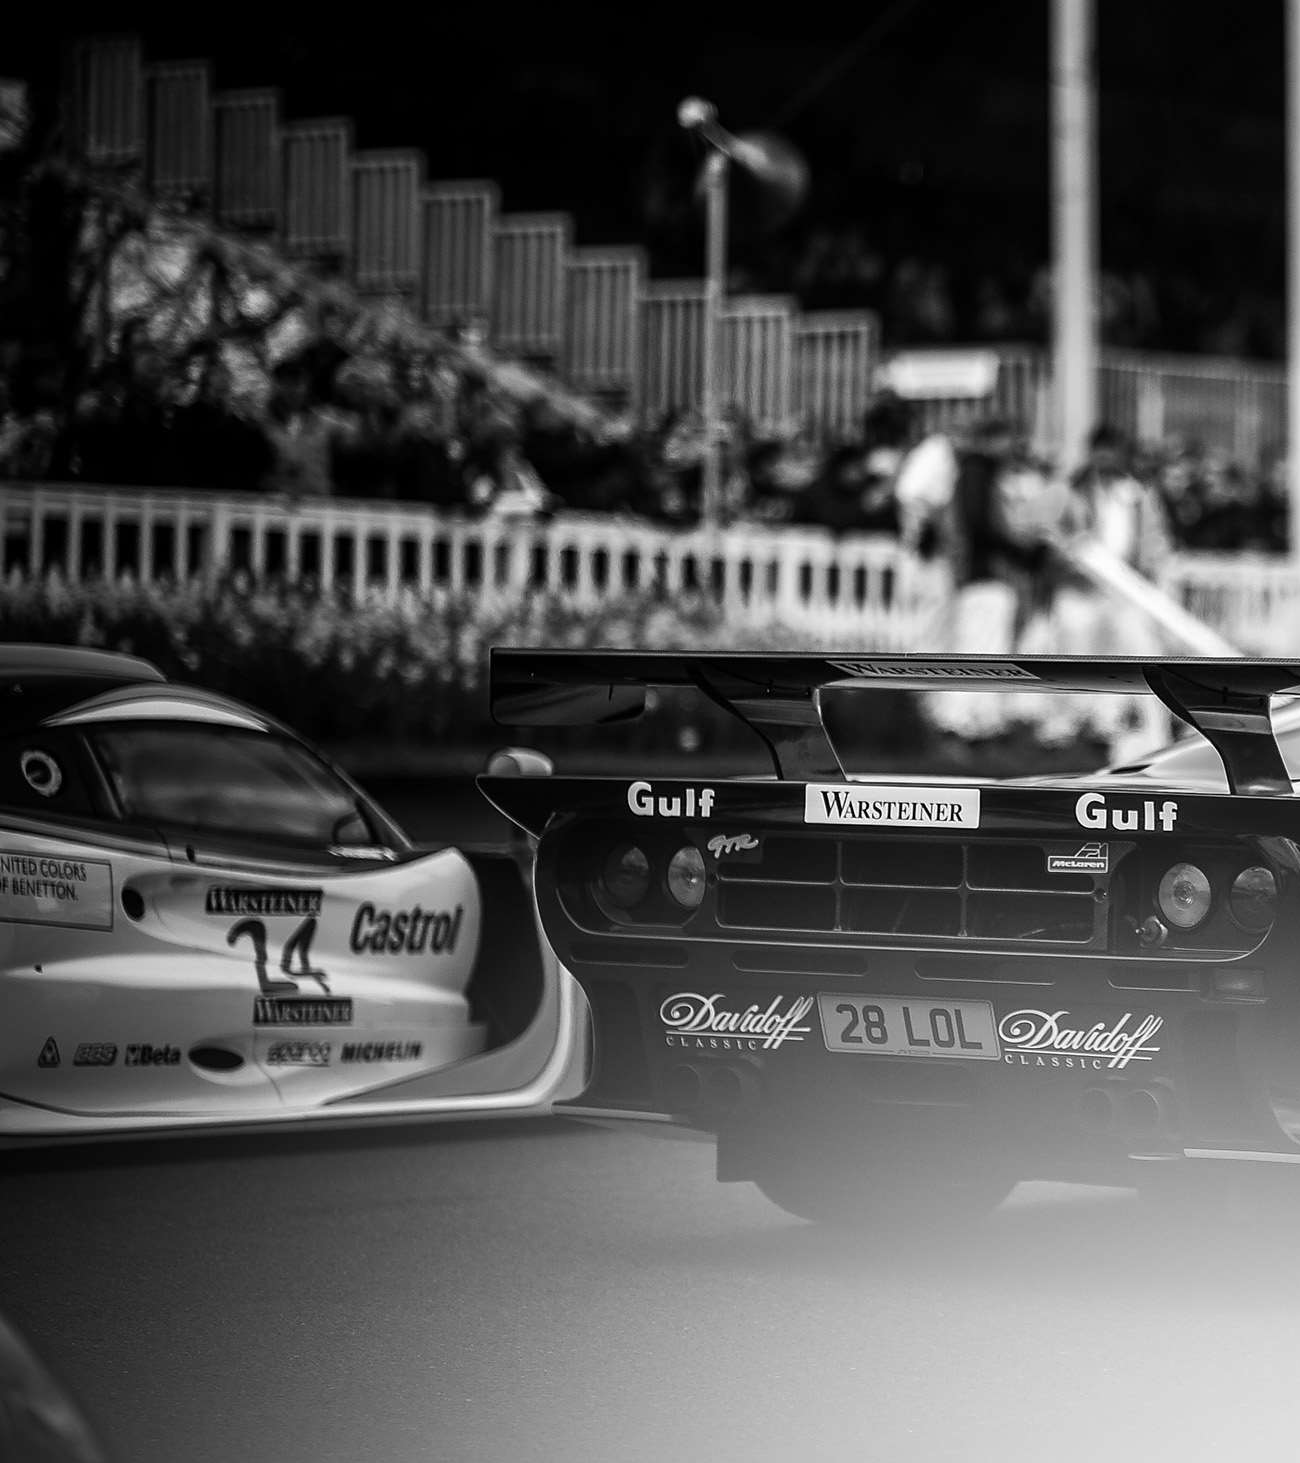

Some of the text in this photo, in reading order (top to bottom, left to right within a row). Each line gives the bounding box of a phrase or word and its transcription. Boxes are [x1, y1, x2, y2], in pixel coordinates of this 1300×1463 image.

[840, 663, 1034, 678] WARSTEINER
[627, 781, 715, 818] Gulf
[819, 790, 963, 823] WARSTEINER
[1075, 792, 1179, 832] Gulf
[40, 860, 88, 882] COLORS
[1051, 860, 1105, 869] McLaren
[350, 902, 463, 955] Castrol
[256, 997, 352, 1024] WARSTEINER
[659, 992, 814, 1049] Davidoff
[836, 1004, 982, 1050] 28 LOL
[999, 1009, 1164, 1069] Davidoff
[340, 1041, 422, 1063] MICHELIN
[665, 1036, 758, 1050] CLASSIC
[1005, 1054, 1101, 1070] CLASSIC
